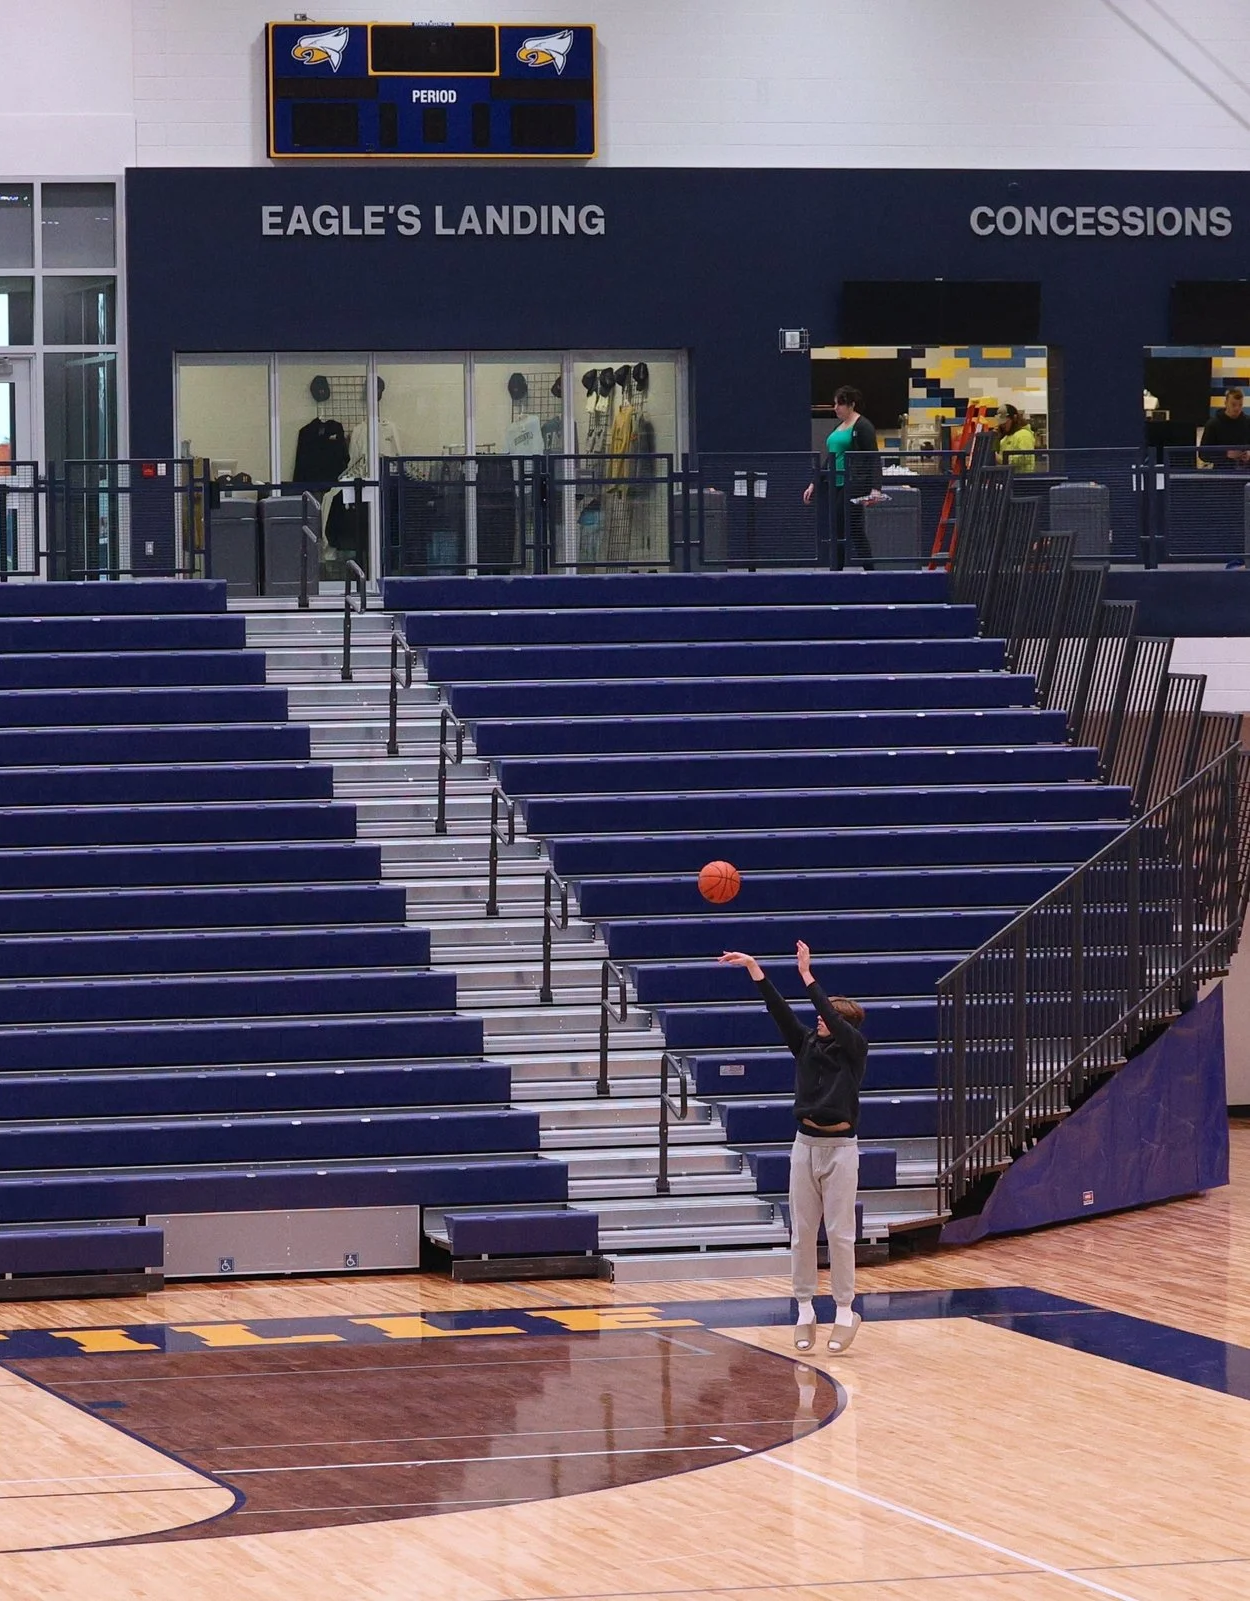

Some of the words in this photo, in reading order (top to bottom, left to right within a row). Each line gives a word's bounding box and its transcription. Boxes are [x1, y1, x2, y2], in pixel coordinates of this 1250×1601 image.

[412, 89, 457, 103] PERIOD
[261, 204, 422, 236] EAGLE'S
[434, 204, 606, 236] LANDING
[969, 206, 1232, 237] CONCESSIONS
